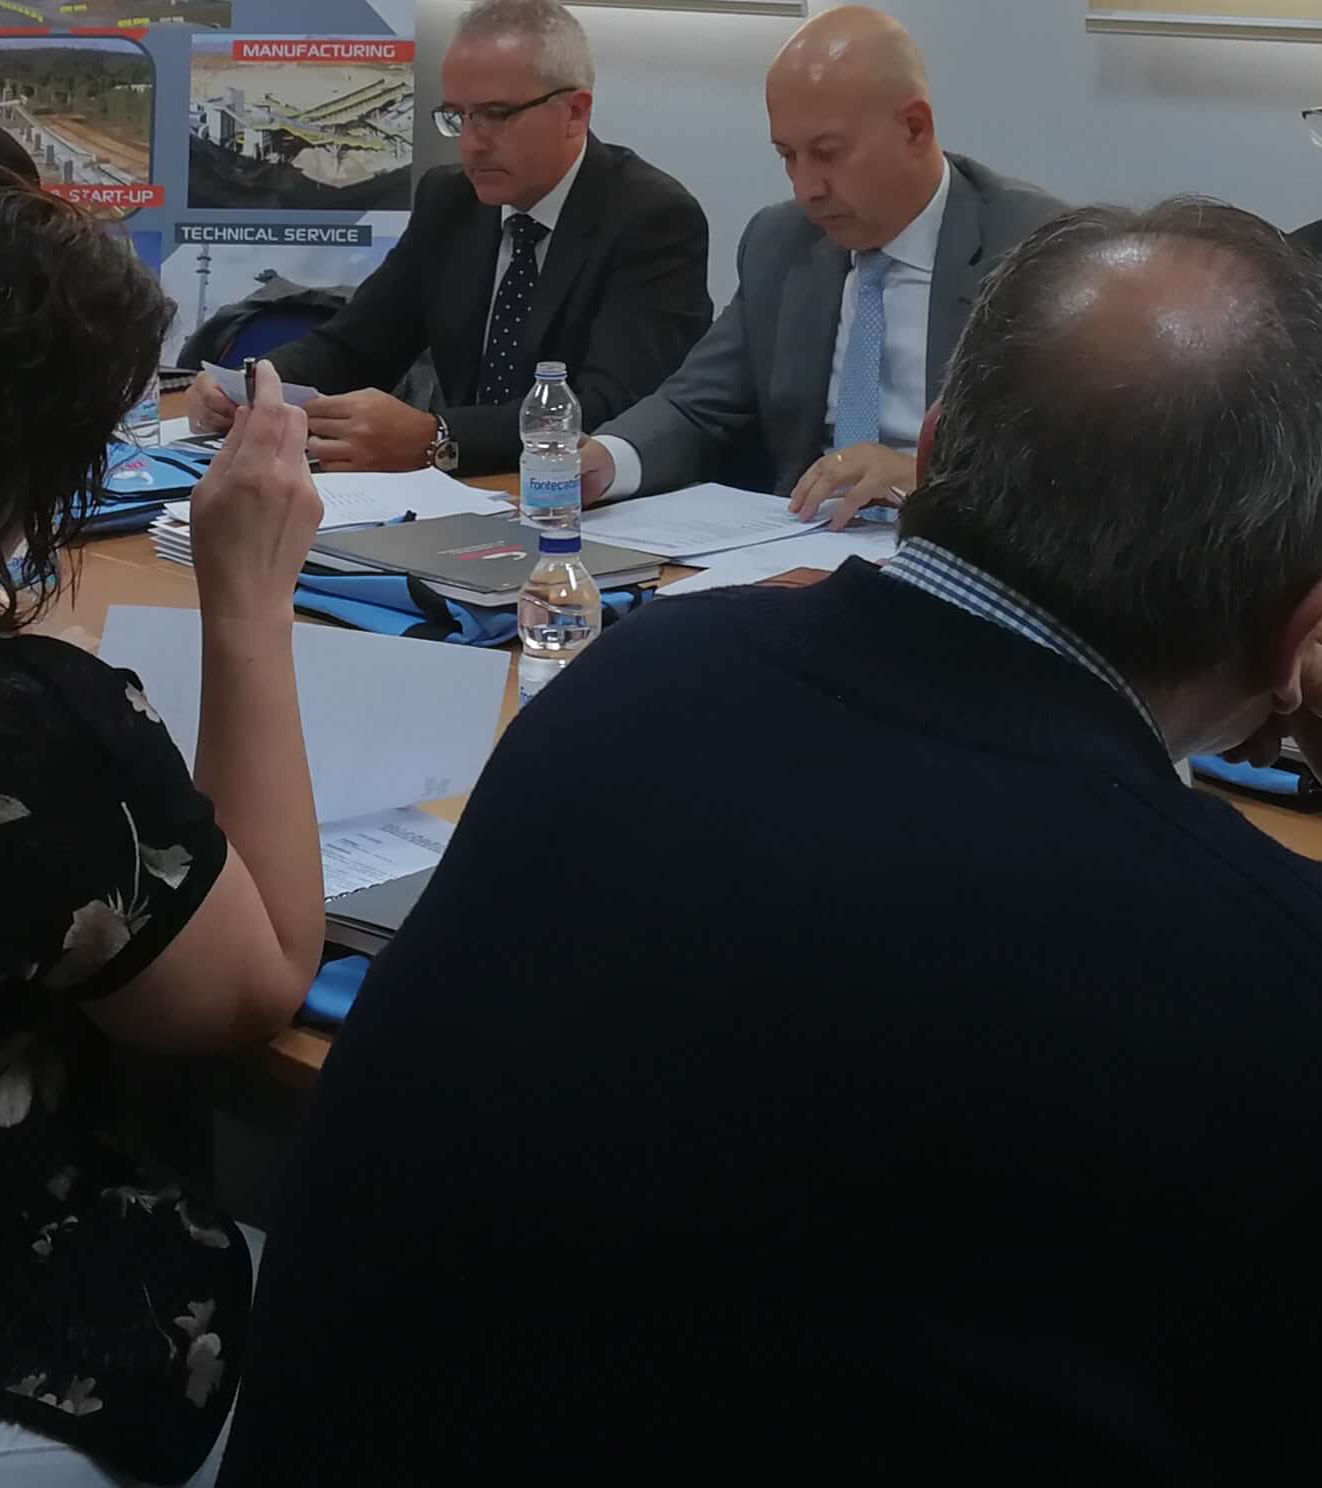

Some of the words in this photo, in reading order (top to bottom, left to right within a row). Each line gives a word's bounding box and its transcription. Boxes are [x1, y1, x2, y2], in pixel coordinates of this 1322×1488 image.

[243, 44, 395, 59] MANUFACTURING
[69, 189, 154, 203] START-UP
[182, 226, 278, 242] TECHNICAL
[284, 226, 358, 243] SERVICE
